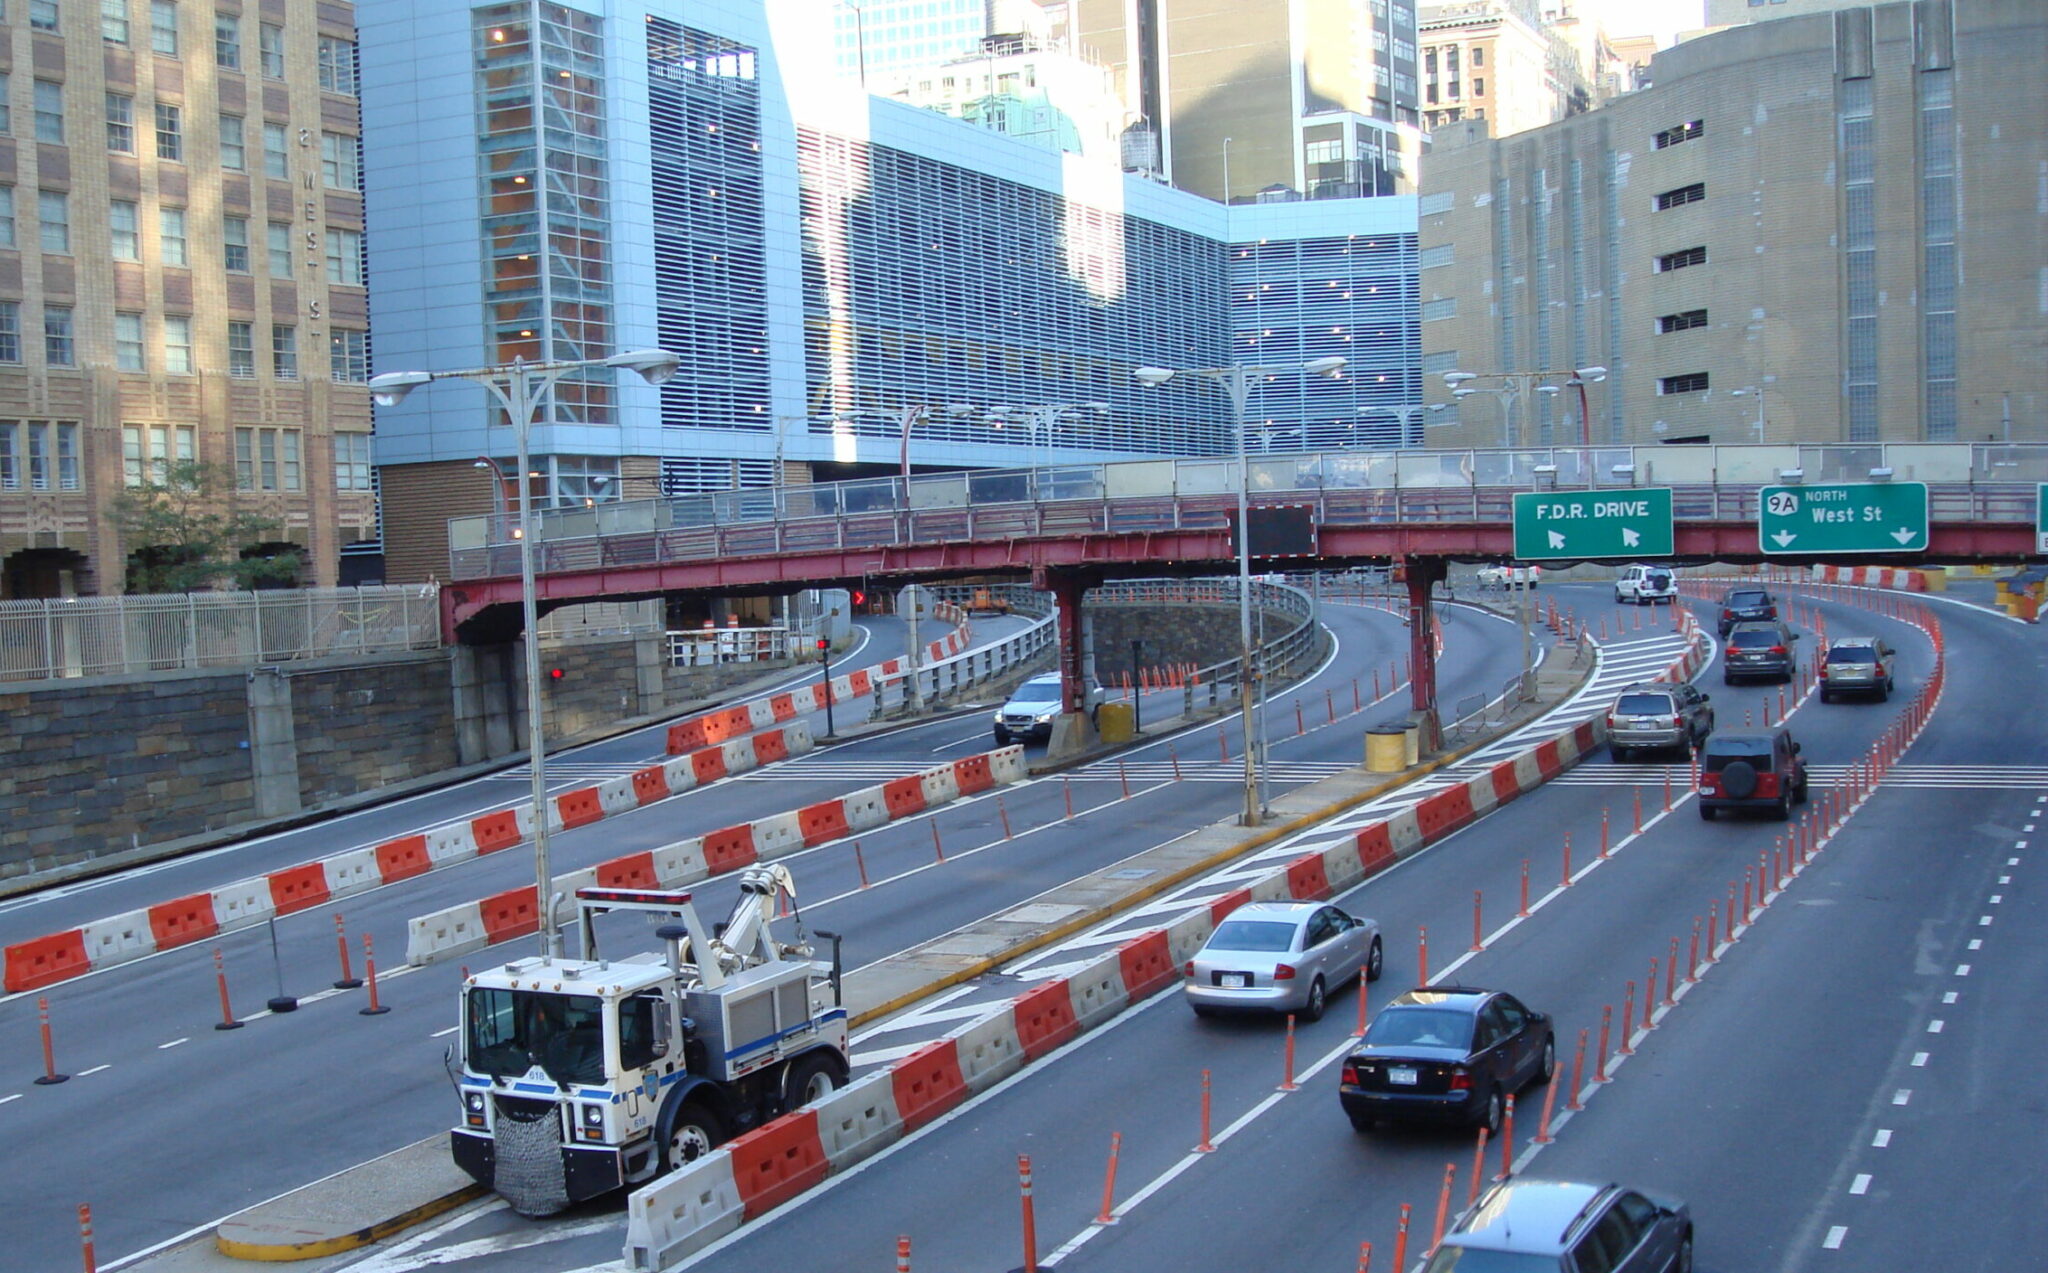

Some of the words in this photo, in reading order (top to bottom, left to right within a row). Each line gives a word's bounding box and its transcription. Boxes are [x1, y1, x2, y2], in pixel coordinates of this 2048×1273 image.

[1769, 496, 1796, 512] 9A
[1804, 490, 1848, 502] NORTH
[1536, 503, 1588, 520] F.D.R.
[1593, 500, 1650, 518] DRIVE
[1811, 507, 1855, 523] West
[1862, 505, 1883, 522] St
[529, 1071, 545, 1081] 618
